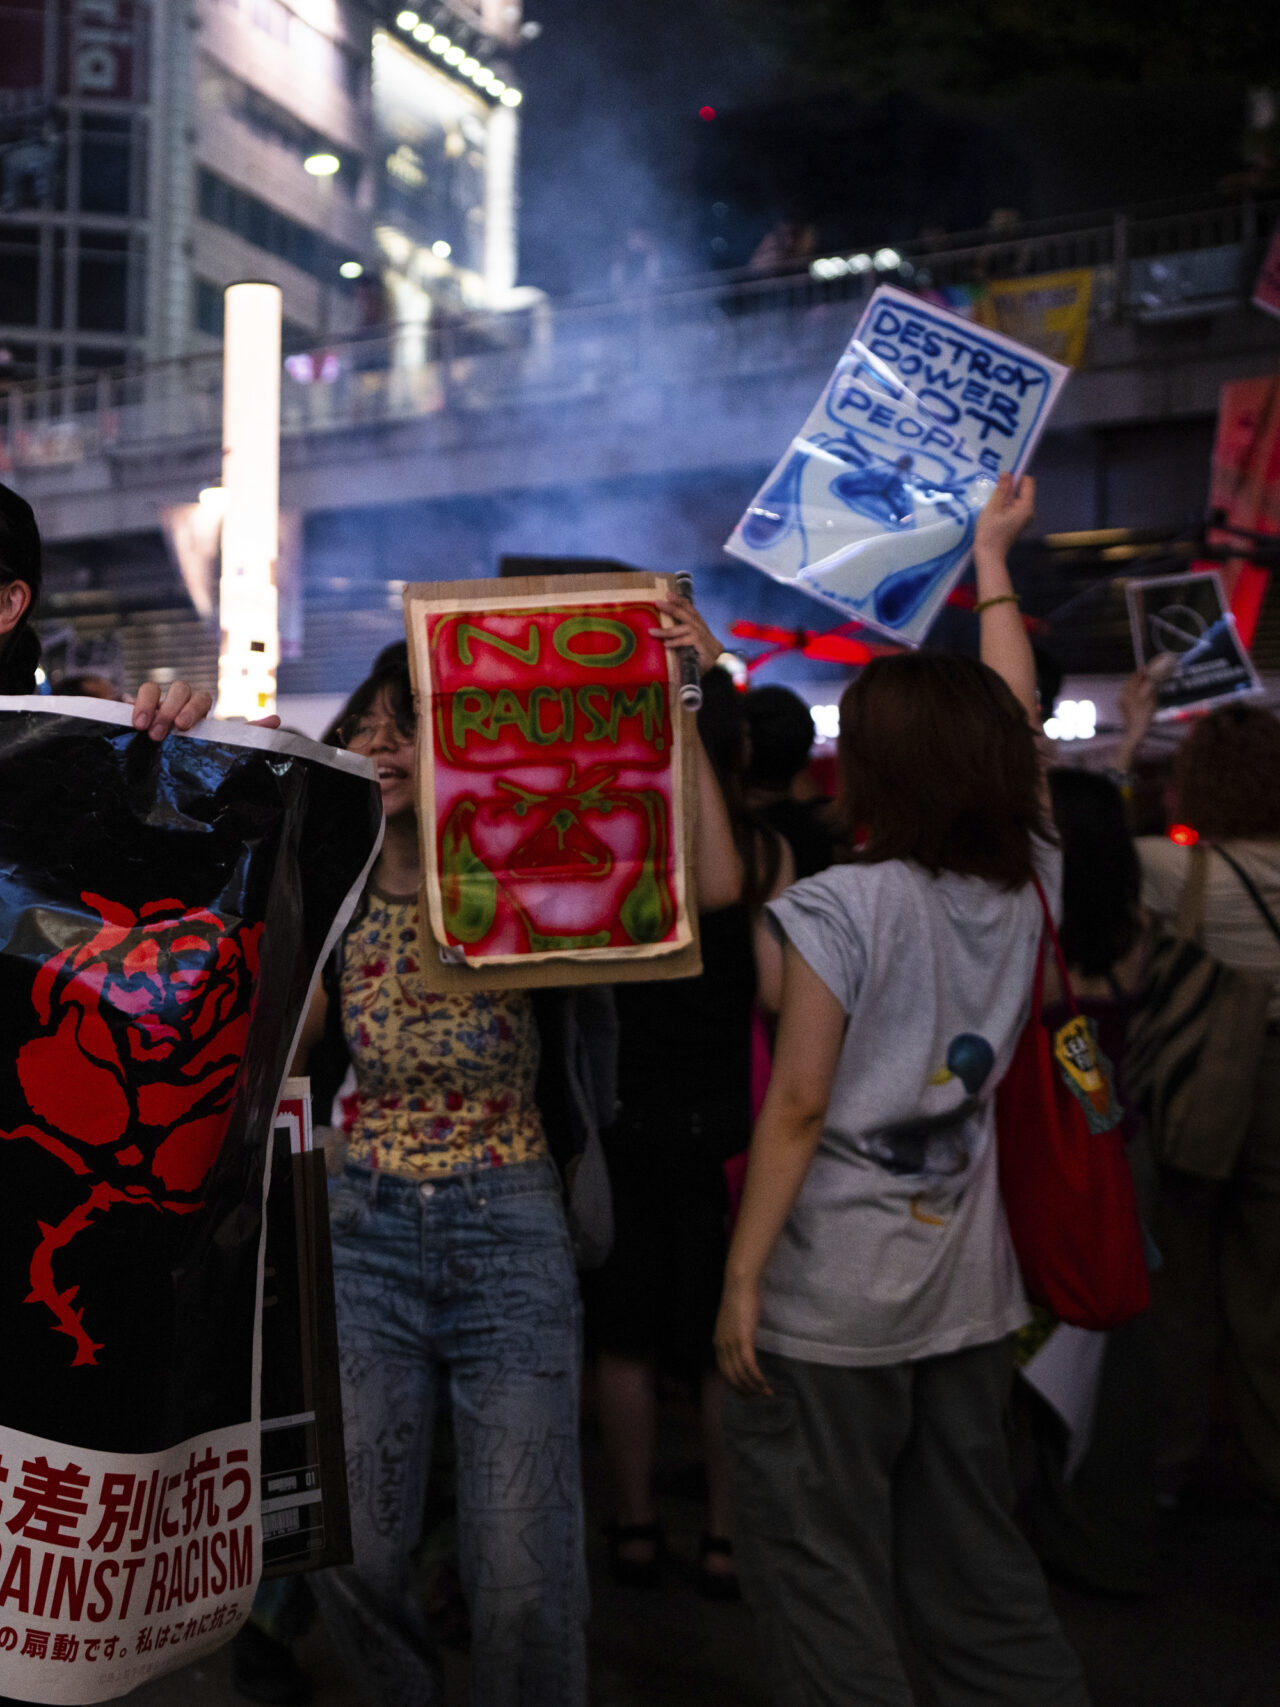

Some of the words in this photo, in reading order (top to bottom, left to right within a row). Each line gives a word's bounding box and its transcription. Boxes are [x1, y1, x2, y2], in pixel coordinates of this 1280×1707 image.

[867, 339, 1020, 427] POWER
[872, 310, 1042, 396] DESTROY
[837, 387, 1002, 471] PEOPLE
[456, 616, 636, 667] NO
[452, 681, 664, 751] RACISM!
[144, 1524, 253, 1617] RACISM
